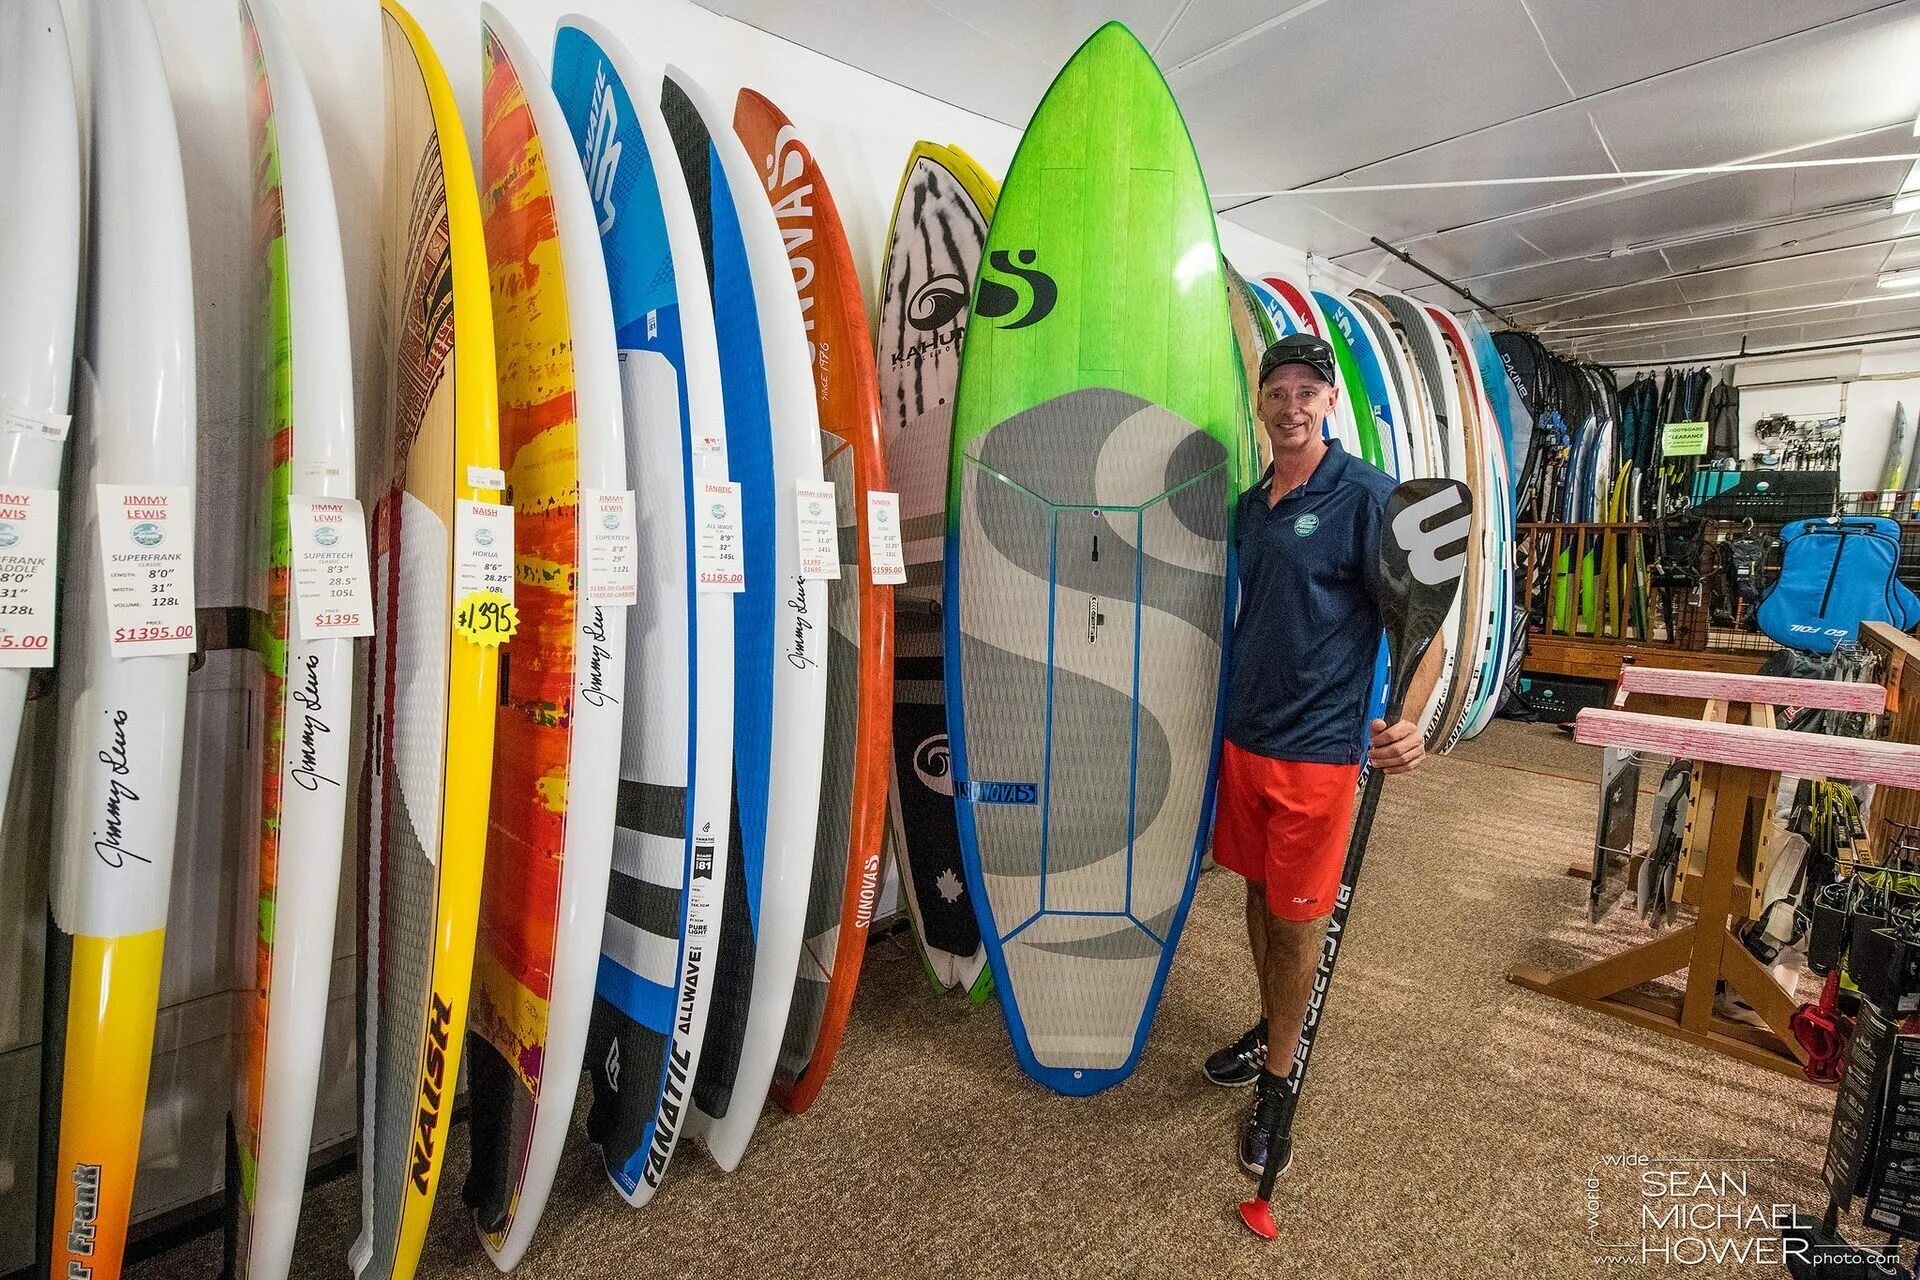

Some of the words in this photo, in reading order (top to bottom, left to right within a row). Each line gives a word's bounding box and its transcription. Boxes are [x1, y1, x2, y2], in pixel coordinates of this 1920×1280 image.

[583, 59, 606, 175] ANATIC
[818, 341, 830, 371] 1976
[1501, 353, 1528, 399] DAKINE
[705, 485, 733, 493] FANATIC
[0, 494, 30, 503] MY
[123, 495, 168, 505] JIMMY
[0, 509, 27, 518] WIS
[127, 509, 167, 519] LEWIS
[312, 504, 343, 512] JIMMY
[472, 506, 498, 517] NAISH
[314, 514, 343, 522] LEWIS
[112, 553, 182, 562] SUPERFRANK
[304, 552, 353, 560] SUPERTECH
[472, 550, 498, 558] HOKUA
[872, 566, 903, 574] $1595.00
[700, 573, 743, 582] $1195.00
[330, 589, 354, 598] 105L
[152, 597, 180, 607] 128L
[315, 614, 360, 627] $1395
[458, 602, 512, 634] $1,395
[114, 625, 194, 642] $1395.00
[1790, 624, 1822, 634] FOIL
[1823, 628, 1849, 637] GO
[786, 616, 819, 670] Jimmy
[579, 644, 620, 707] Jimmy
[1422, 697, 1446, 744] ANATIC
[1442, 706, 1469, 754] FANATIC
[290, 714, 342, 791] Jimmy
[961, 781, 1017, 802] SUNOVA
[93, 778, 152, 868] Jimmy
[855, 872, 878, 929] SUNOVA
[678, 951, 702, 1036] ALLWAVE
[410, 992, 453, 1197] NAISH
[642, 1035, 691, 1189] FANATIC
[66, 1163, 101, 1256] Frank
